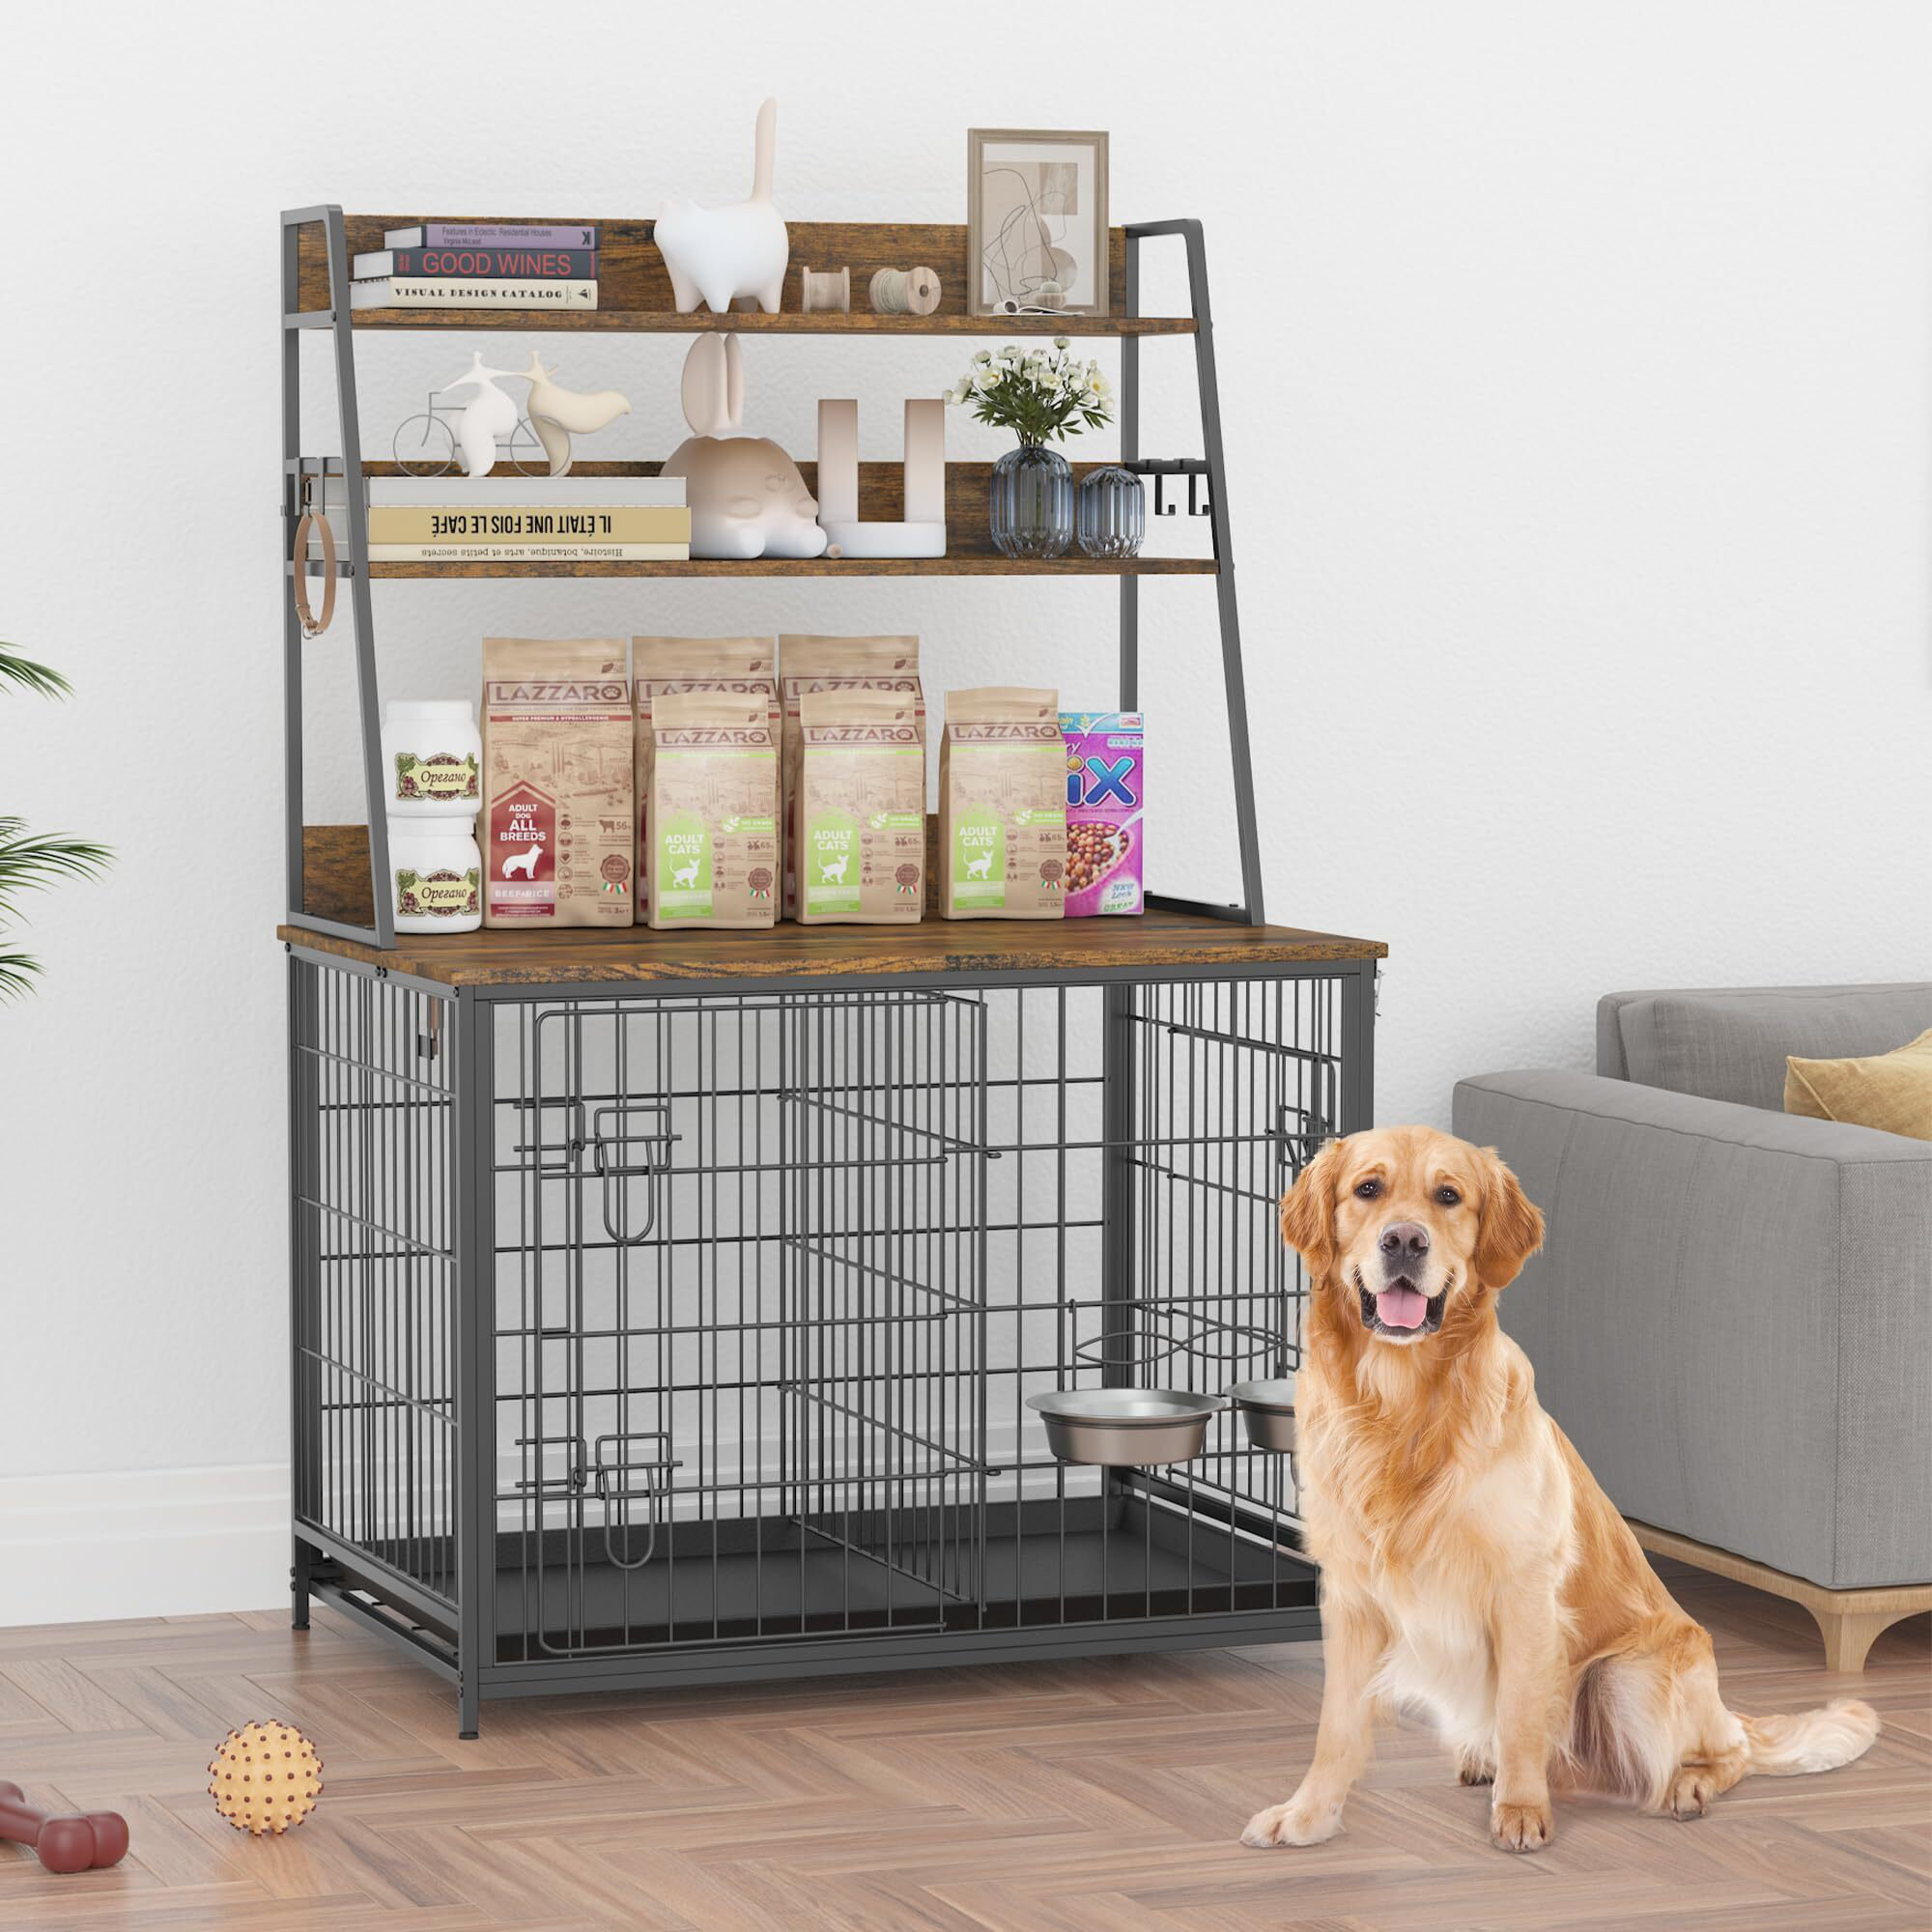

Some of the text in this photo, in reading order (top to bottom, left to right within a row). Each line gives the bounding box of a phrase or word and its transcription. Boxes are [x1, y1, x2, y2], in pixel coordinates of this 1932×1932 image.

[422, 252, 492, 274] GOOD
[497, 253, 572, 275] WINES
[395, 288, 562, 298] VISUAL DESIGN CATALOG
[431, 515, 611, 538] IL ÉTAIT UNE FOIS LE CAFÉ
[421, 548, 623, 557] Histoire, botanique, arts et petits secrets
[496, 685, 622, 700] LAZZARO
[809, 728, 914, 741] LAZZARO
[954, 725, 1058, 738] LAZZARO
[661, 731, 767, 744] LAZZARO
[420, 770, 467, 786] Орегано
[509, 804, 539, 812] ADULT
[509, 819, 537, 831] ALL
[813, 830, 852, 839] ADULT
[958, 826, 998, 836] ADULT
[499, 832, 547, 841] BREEDS
[665, 835, 704, 844] ADULT
[962, 837, 994, 846] CATS
[668, 844, 700, 854] CATS
[817, 840, 849, 850] CATS
[421, 887, 468, 903] Орегано
